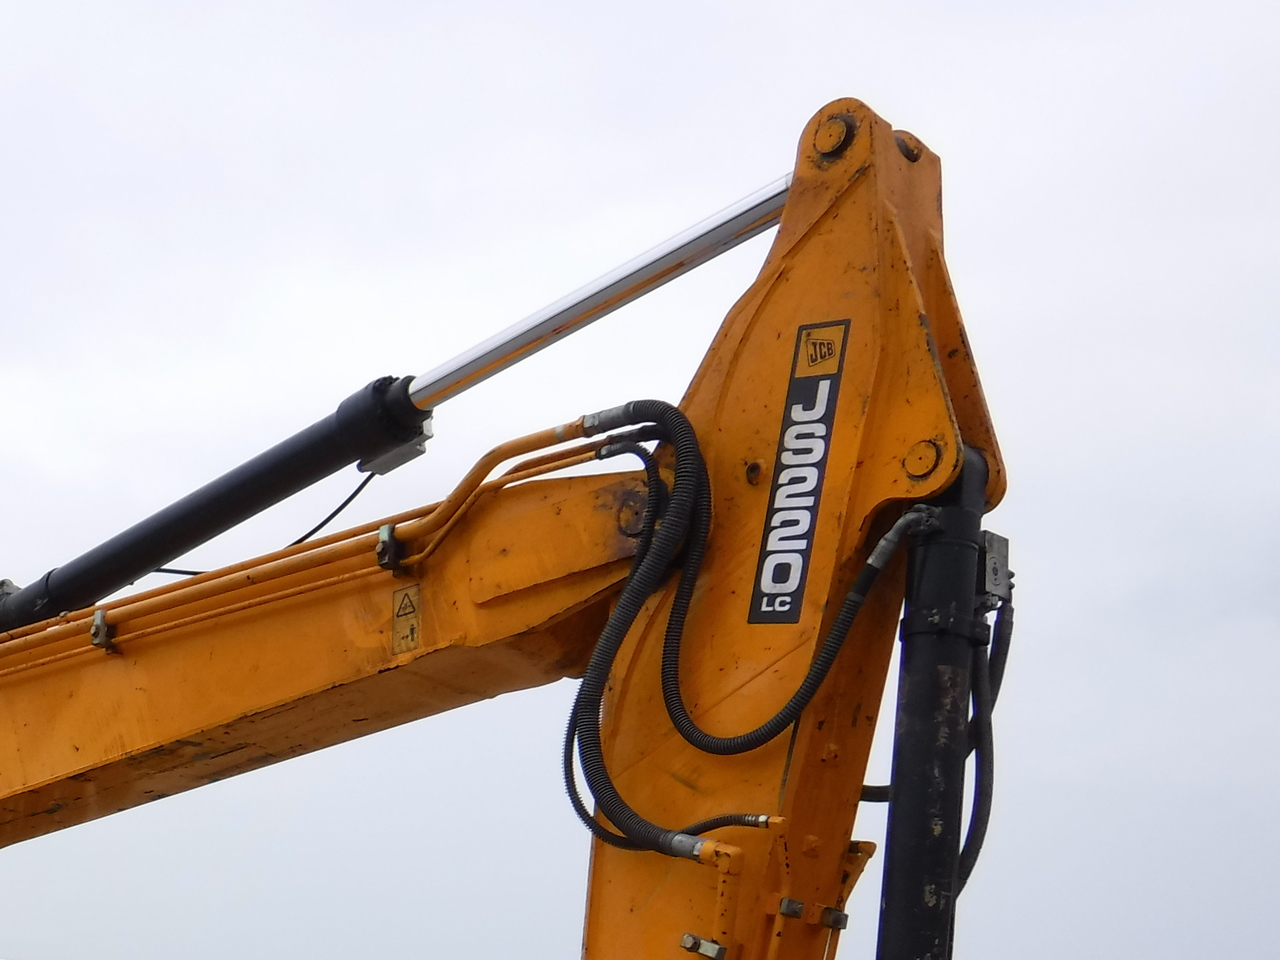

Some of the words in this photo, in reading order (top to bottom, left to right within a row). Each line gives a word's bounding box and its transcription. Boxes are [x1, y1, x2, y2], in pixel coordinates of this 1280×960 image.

[809, 341, 834, 364] JCB
[760, 379, 831, 594] JS220
[760, 596, 792, 612] LC
